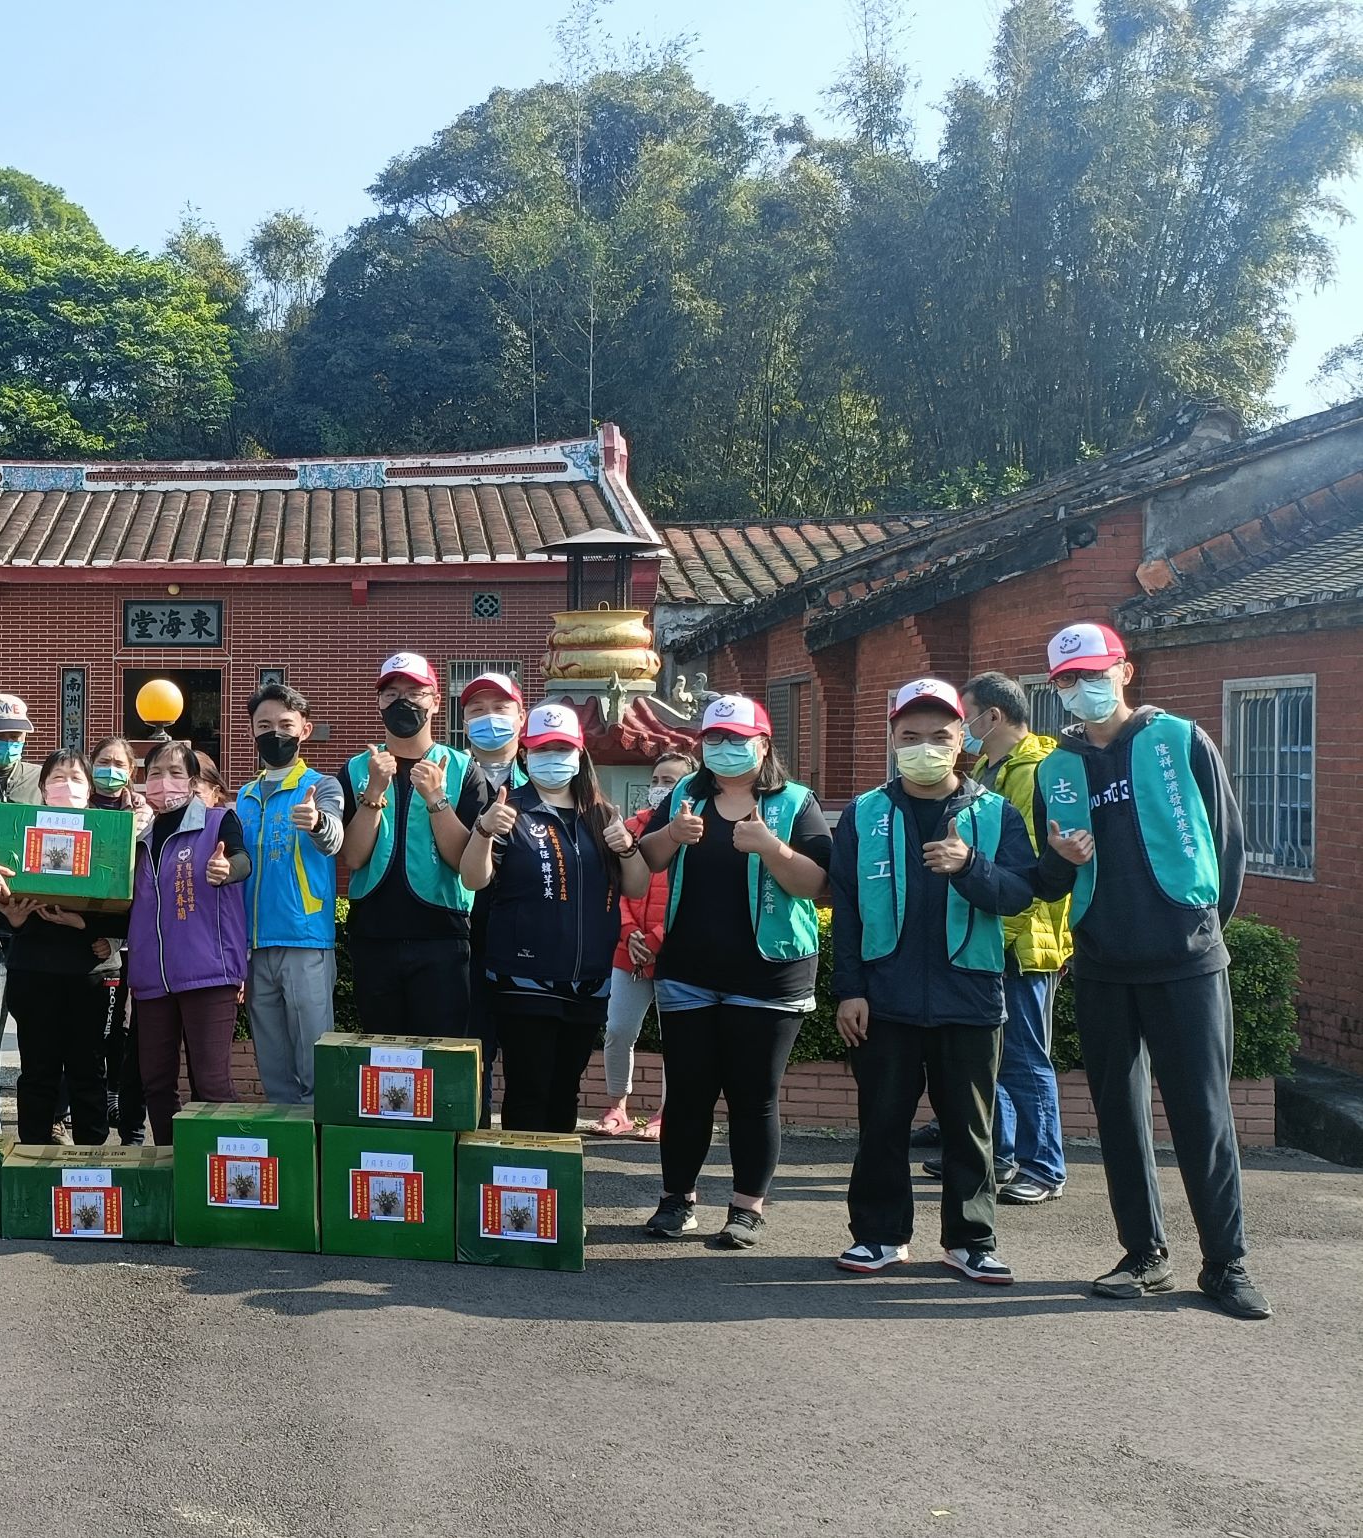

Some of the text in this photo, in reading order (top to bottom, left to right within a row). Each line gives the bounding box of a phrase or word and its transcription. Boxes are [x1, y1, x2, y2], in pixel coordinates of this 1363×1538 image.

[130, 609, 216, 639] 東海堂
[66, 677, 80, 750] 南洲世澤
[1154, 743, 1197, 859] 隆祥經濟發展基金會
